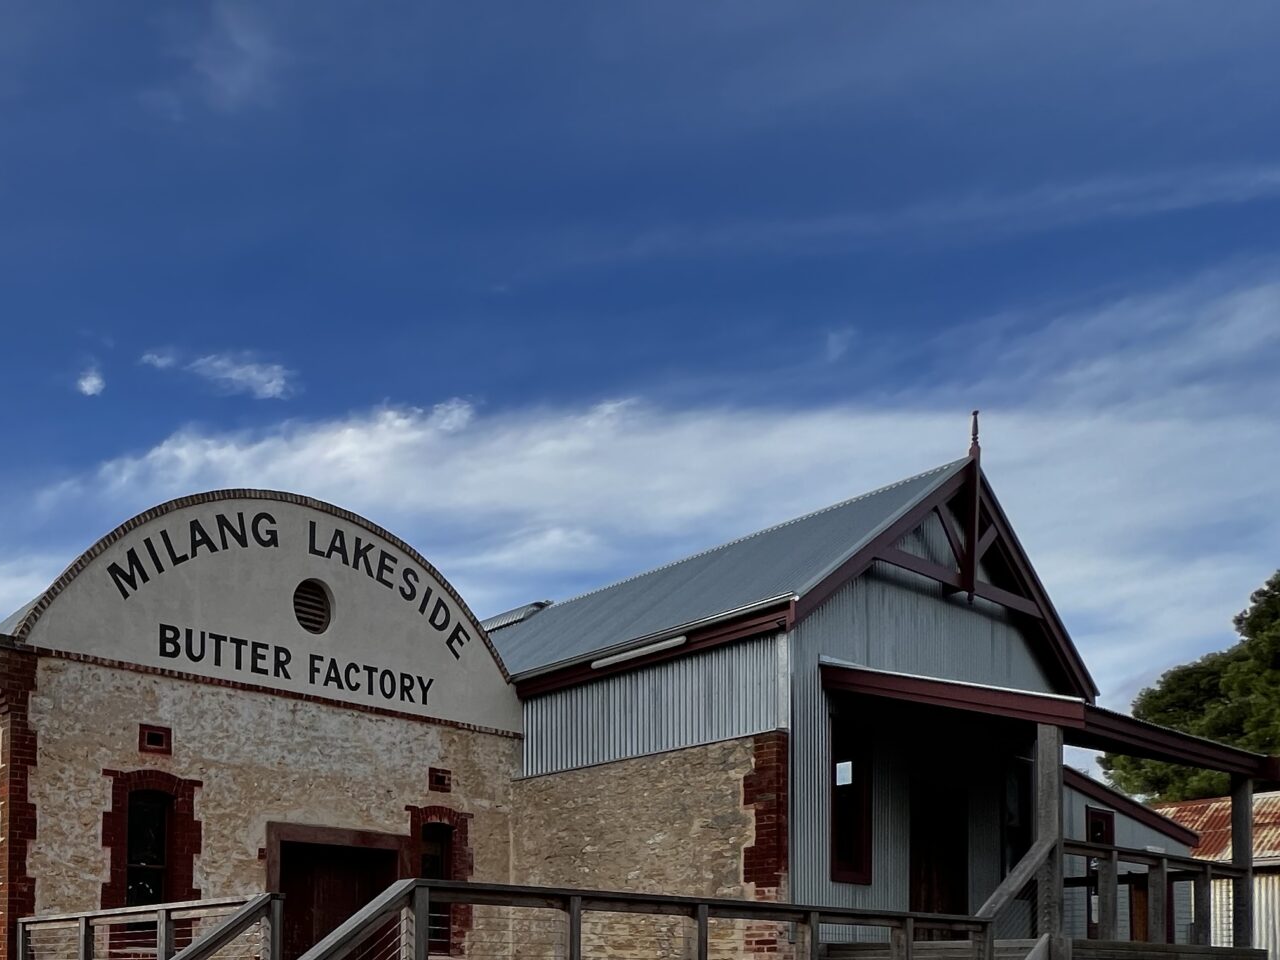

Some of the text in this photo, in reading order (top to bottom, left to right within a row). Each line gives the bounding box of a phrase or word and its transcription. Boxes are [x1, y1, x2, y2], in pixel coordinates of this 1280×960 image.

[106, 511, 471, 661] MILANG LAKESIDE
[158, 623, 434, 705] BUTTER FACTORY
